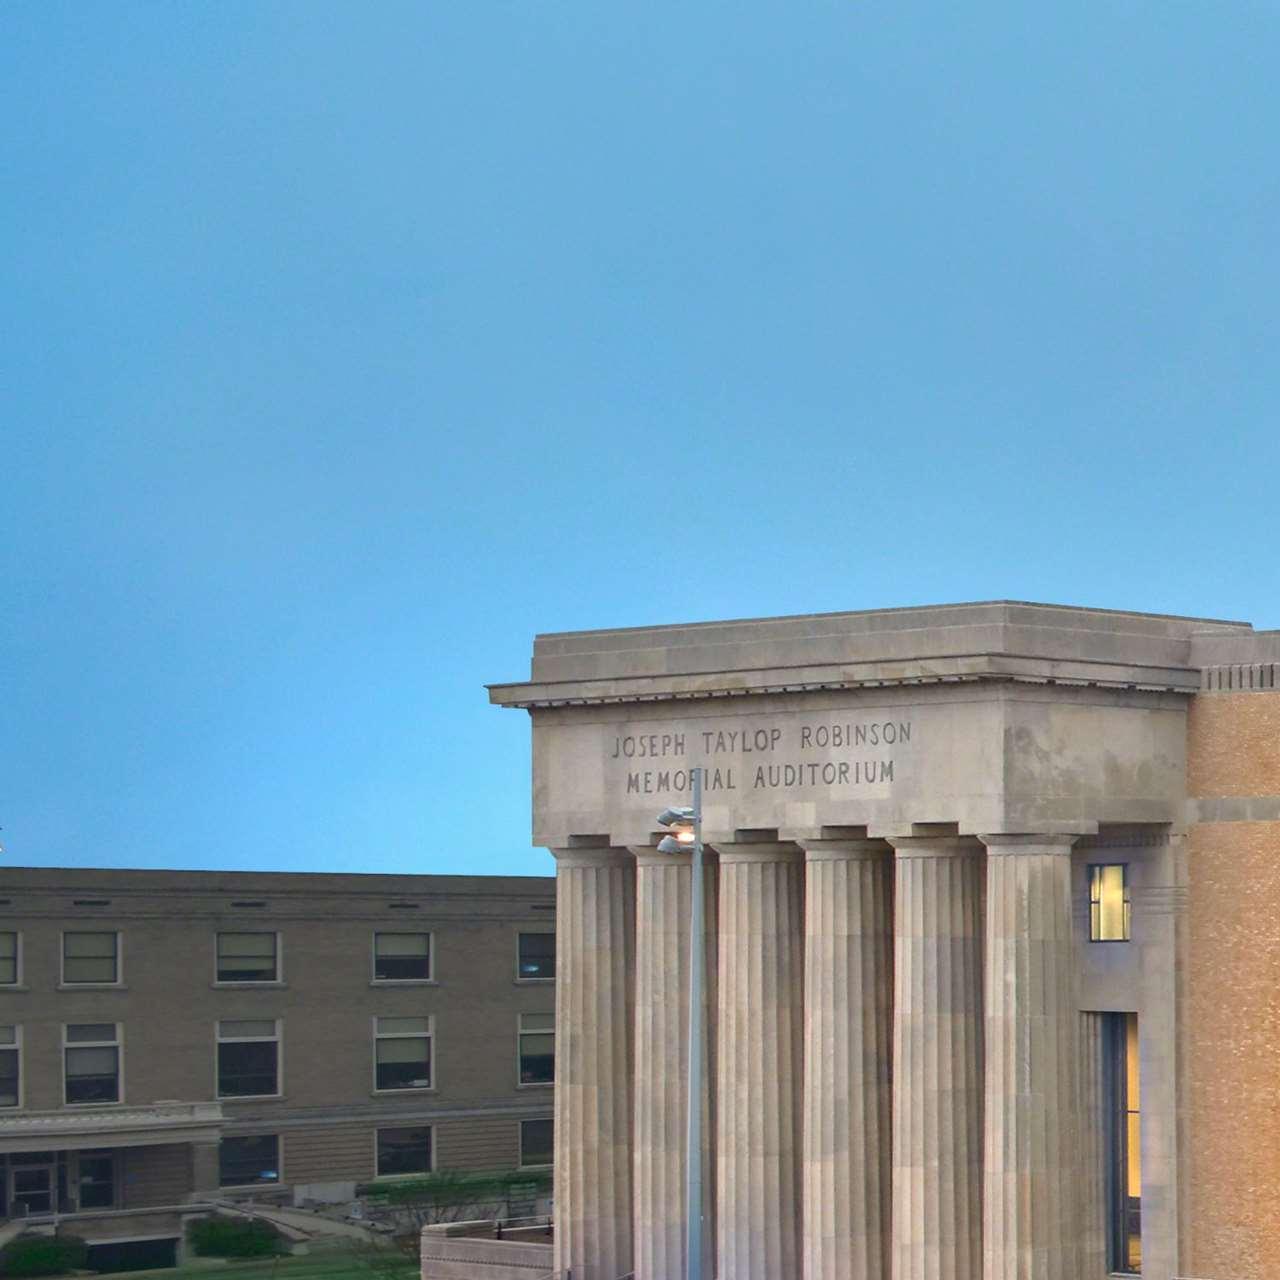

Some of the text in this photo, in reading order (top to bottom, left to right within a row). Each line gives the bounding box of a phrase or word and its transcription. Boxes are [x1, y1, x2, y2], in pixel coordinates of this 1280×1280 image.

[612, 733, 686, 759] JOSEPH
[801, 721, 912, 749] ROBINSON
[754, 760, 895, 788] AUDITORIUM
